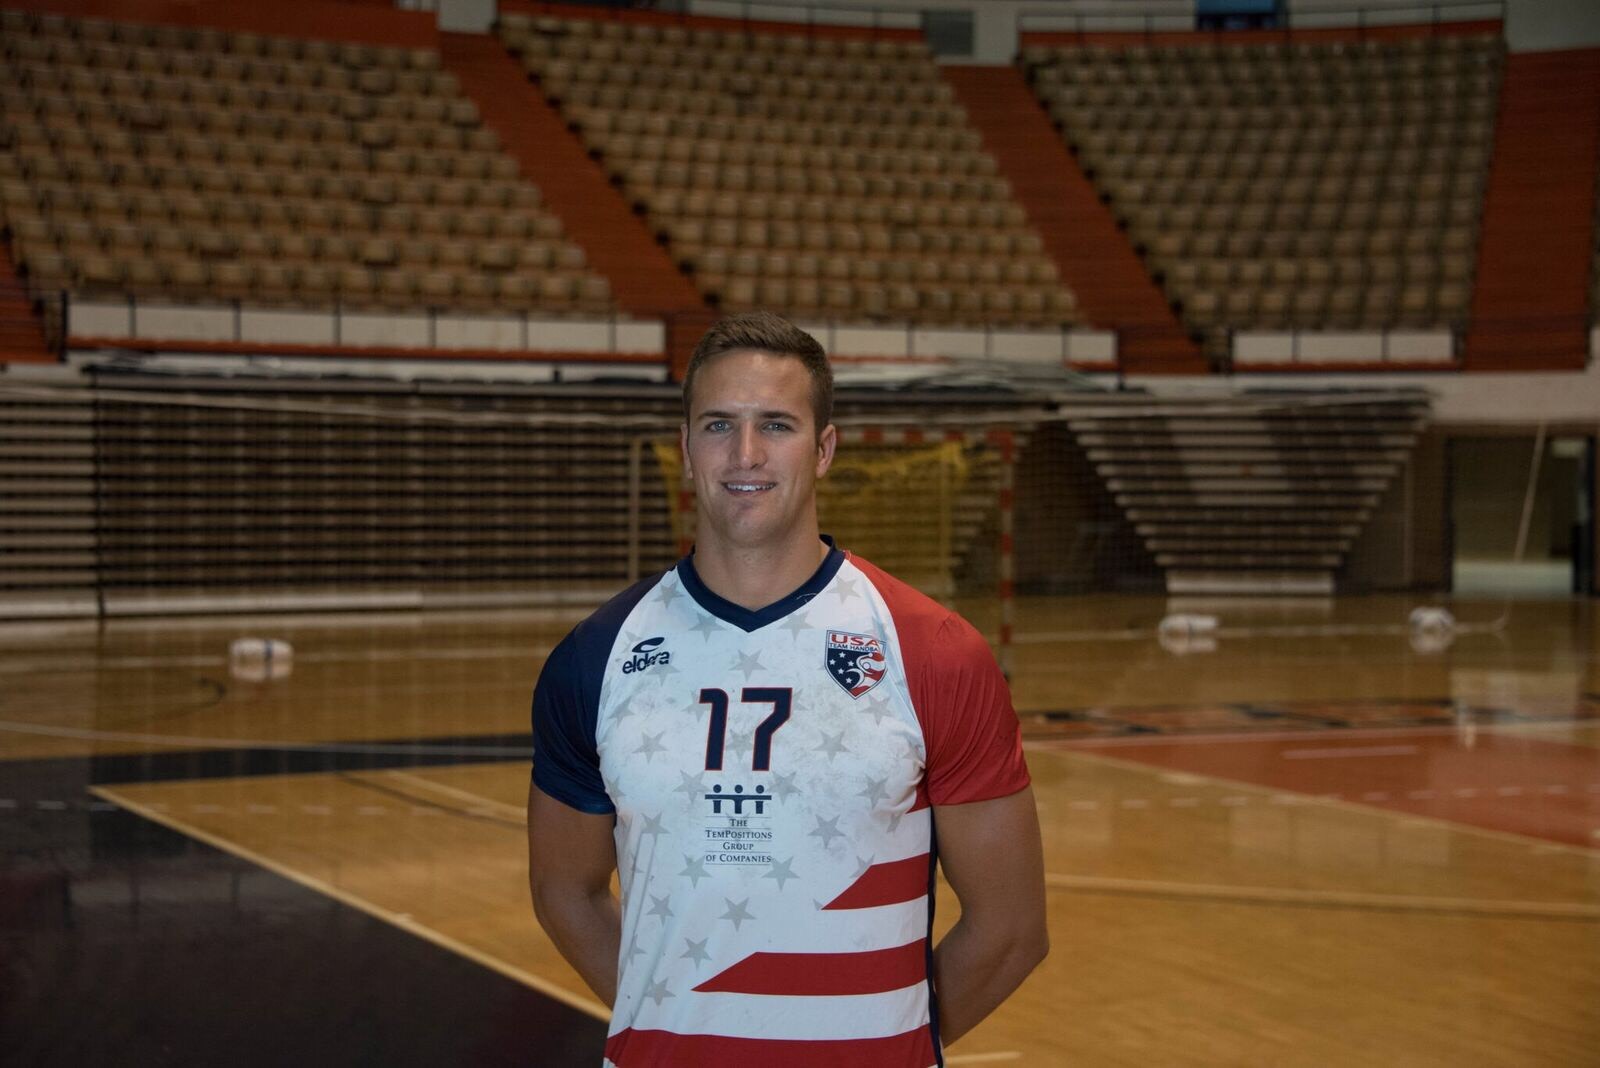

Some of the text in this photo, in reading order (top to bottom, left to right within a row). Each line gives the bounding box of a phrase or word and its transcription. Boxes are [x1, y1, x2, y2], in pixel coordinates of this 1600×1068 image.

[831, 633, 880, 647] USA
[622, 651, 670, 674] eldera
[698, 687, 793, 772] 17
